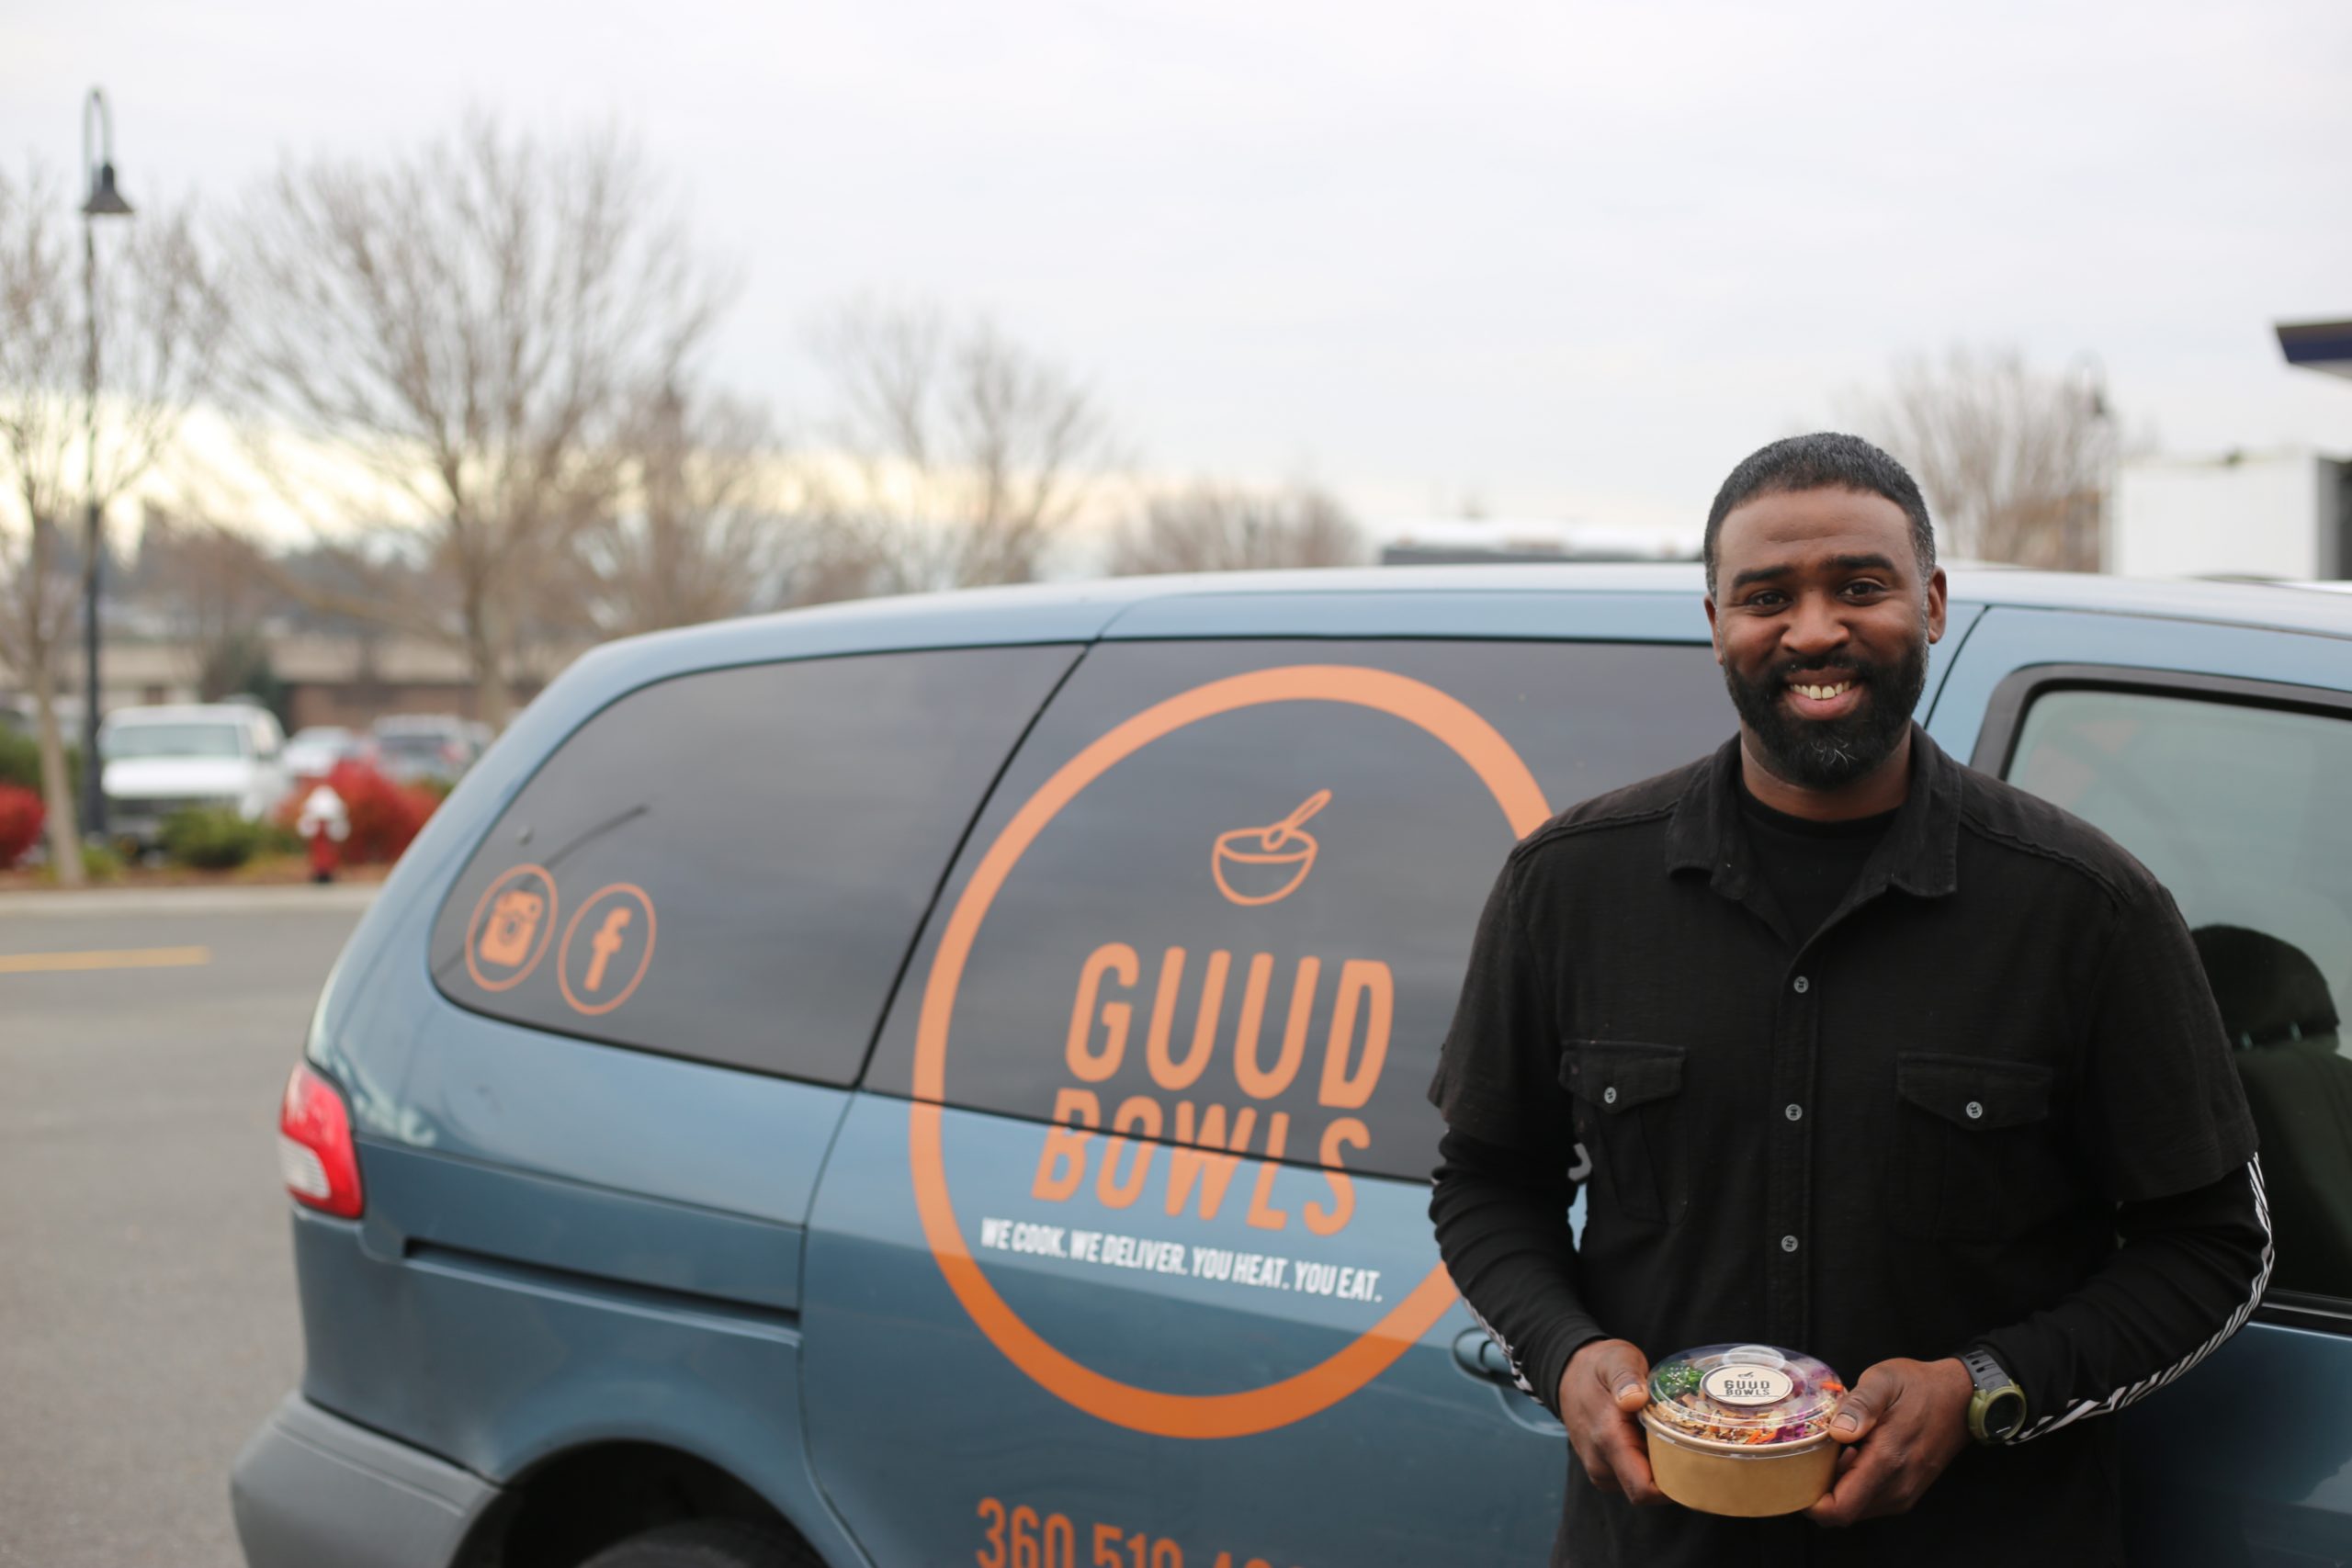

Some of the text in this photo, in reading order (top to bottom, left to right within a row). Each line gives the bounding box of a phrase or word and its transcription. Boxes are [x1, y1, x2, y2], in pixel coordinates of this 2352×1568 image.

[1065, 942, 1395, 1109] GUUD
[1031, 1089, 1371, 1235] BOWLS
[981, 1217, 1383, 1303] WE COOK. WE DELIVER. YOU HEAT. YOU EAT.
[1724, 1380, 1770, 1389] GUUD
[976, 1496, 1075, 1568] 360
